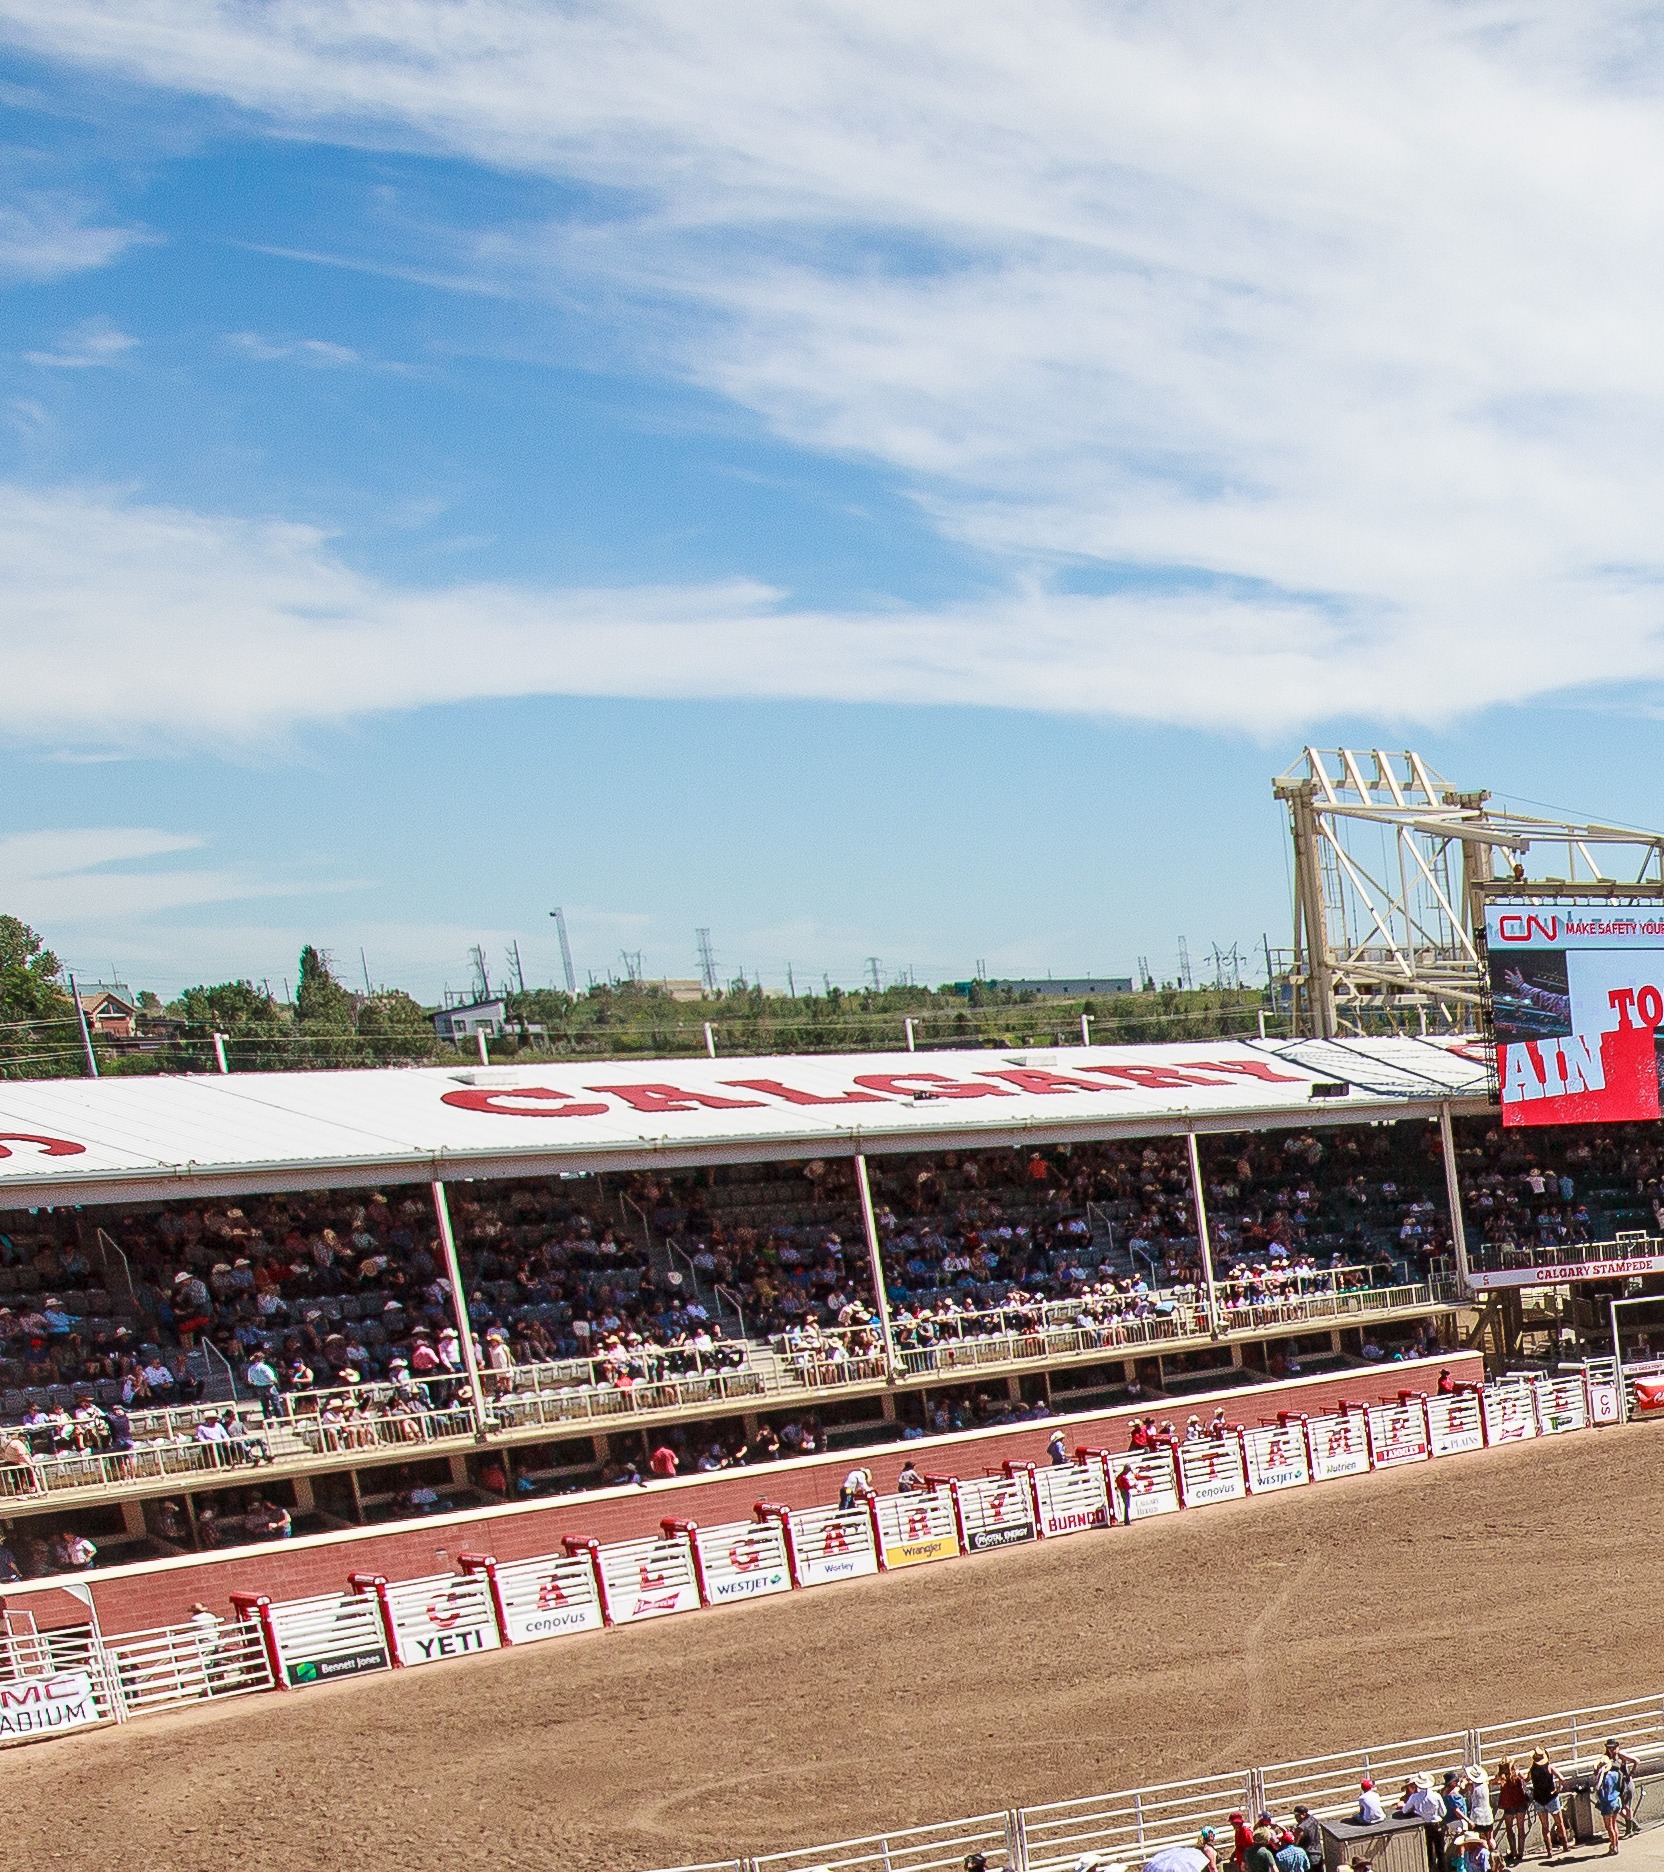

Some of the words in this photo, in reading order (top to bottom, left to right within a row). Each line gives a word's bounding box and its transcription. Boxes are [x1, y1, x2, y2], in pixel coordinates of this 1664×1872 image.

[1499, 914, 1558, 942] CN
[1565, 923, 1597, 935] MAKE
[1598, 923, 1638, 935] SAFETY
[440, 1060, 1310, 1118] CALGARY
[1536, 1264, 1591, 1280] CALGARY
[1592, 1260, 1653, 1275] STAMPEDE
[1450, 1434, 1480, 1450] PLAINS
[1325, 1461, 1357, 1475] Nutrien
[1256, 1471, 1293, 1487] WESTJET
[1195, 1484, 1236, 1499] cenovus
[1048, 1507, 1106, 1532] BURNCO
[902, 1542, 943, 1558] Wrangler
[824, 1561, 855, 1575] Worley
[716, 1576, 770, 1596] WESTJET
[525, 1611, 586, 1633] cenovus
[416, 1629, 485, 1658] YETI
[321, 1659, 356, 1674] Bennett
[356, 1655, 381, 1668] Jones
